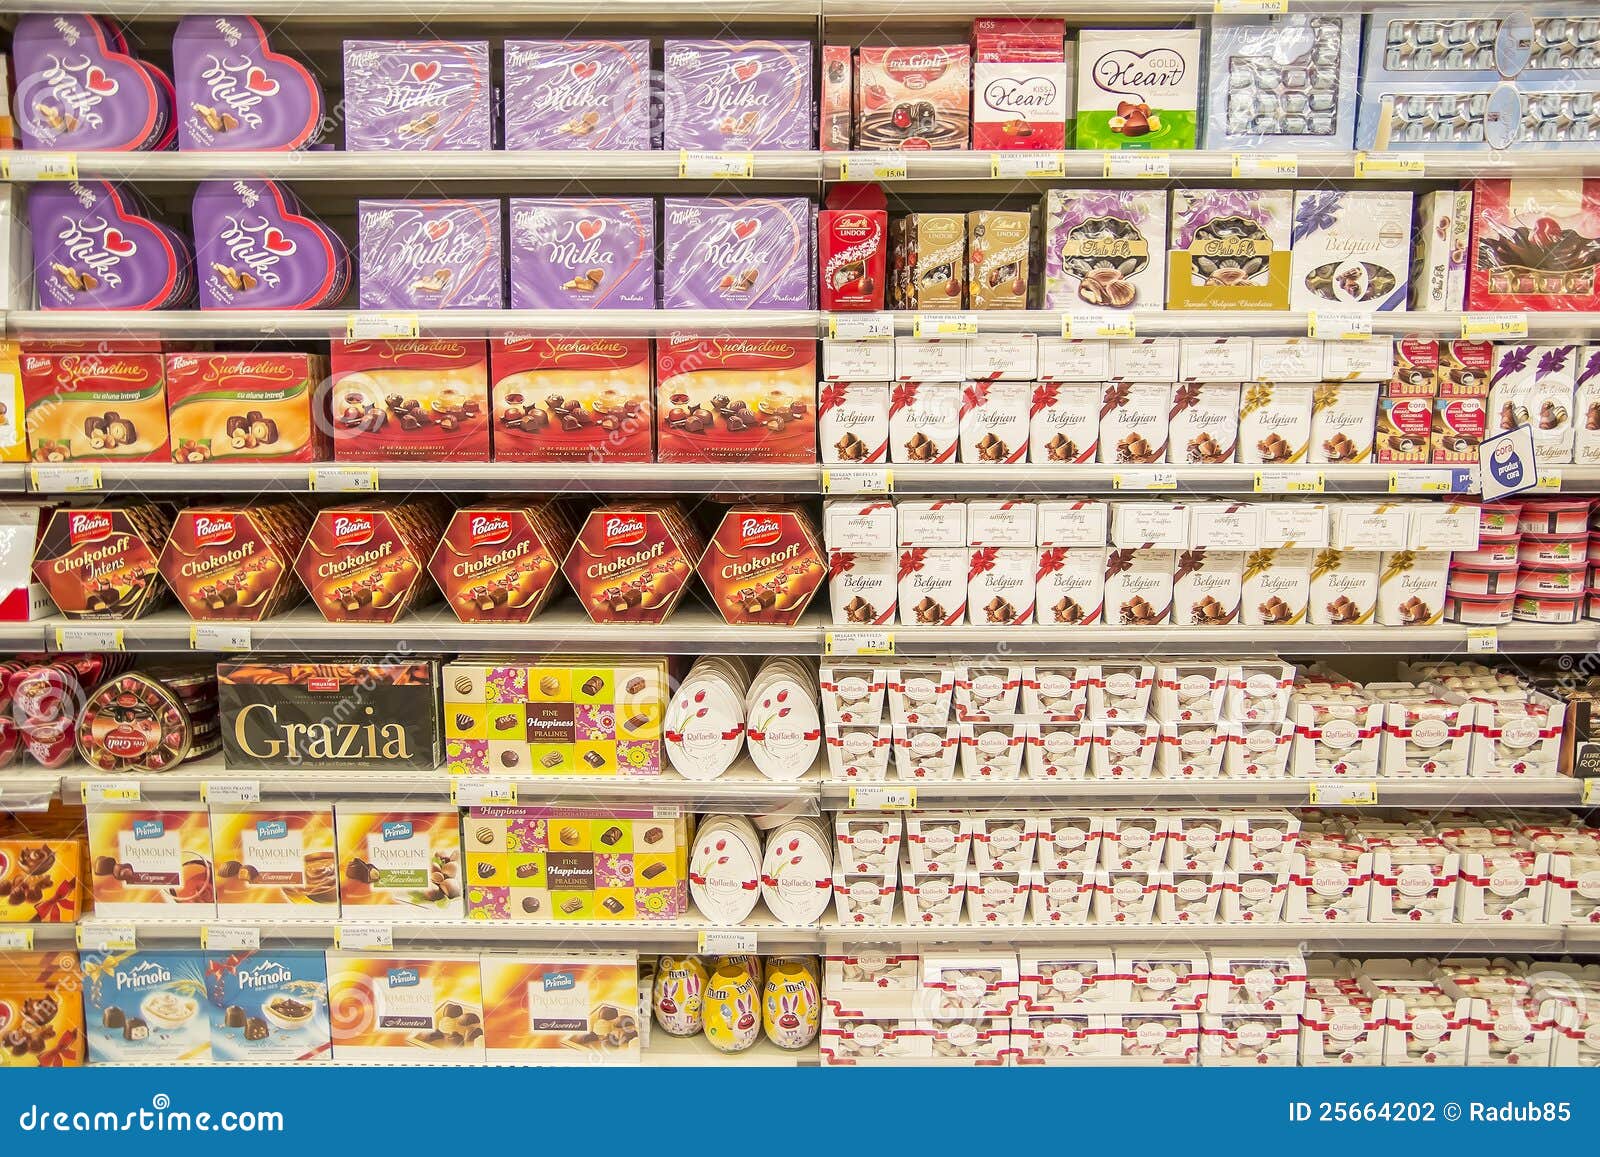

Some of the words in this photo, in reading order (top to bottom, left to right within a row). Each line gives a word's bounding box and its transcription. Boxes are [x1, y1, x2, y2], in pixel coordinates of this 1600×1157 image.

[978, 21, 996, 30] KISS
[909, 53, 944, 69] Gioli
[1148, 59, 1178, 69] GOLD
[1100, 59, 1182, 87] Heart
[42, 54, 103, 130] Milka
[202, 54, 263, 130] Milka
[697, 81, 772, 113] Milka
[990, 86, 1054, 107] Heart
[886, 170, 905, 178] 15.04
[669, 207, 702, 225] Milka
[839, 219, 860, 228] Lindt
[58, 215, 122, 289] Milka
[221, 215, 281, 288] Milka
[547, 240, 614, 269] Milka
[705, 240, 769, 269] Milka
[1325, 236, 1381, 260] Belgian
[868, 325, 879, 333] 21
[957, 322, 967, 330] 22
[1350, 322, 1360, 330] 14
[1500, 322, 1510, 331] 19
[381, 331, 465, 362] Suchardine
[540, 332, 627, 362] Suchardine
[707, 332, 795, 362] Suchardine
[26, 357, 52, 370] Poiana
[57, 357, 147, 382] Suchardine
[173, 358, 199, 370] Poiana
[203, 357, 293, 383] Suchardine
[246, 391, 264, 400] alune
[835, 410, 875, 429] Belgian
[905, 410, 946, 429] Belgian
[976, 410, 1017, 429] Belgian
[1046, 410, 1086, 429] Belgian
[1118, 410, 1157, 429] Belgian
[1188, 410, 1227, 429] Belgian
[1259, 411, 1298, 429] Belgian
[1325, 411, 1364, 429] Belgian
[1494, 442, 1514, 457] cora
[1534, 445, 1569, 459] Belgian
[1498, 461, 1520, 477] produs
[1506, 470, 1520, 481] cora
[862, 479, 872, 488] 12
[1153, 473, 1163, 482] 12
[1297, 483, 1315, 491] 12.21
[72, 516, 110, 535] Poiana
[195, 519, 233, 538] Poiana
[334, 517, 372, 536] Poiana
[472, 517, 510, 536] Poiana
[606, 518, 644, 537] Poiana
[742, 518, 780, 537] Poiana
[54, 536, 131, 575] Chokotoff
[181, 541, 255, 577] Chokotoff
[317, 541, 393, 578] Chokotoff
[453, 540, 531, 578] Chokotoff
[586, 541, 665, 579] Chokotoff
[721, 543, 800, 579] Chokotoff
[85, 557, 125, 581] Intens
[843, 576, 882, 592] Belgian
[913, 576, 952, 592] Belgian
[984, 576, 1024, 592] Belgian
[1053, 576, 1092, 592] Belgian
[1121, 576, 1161, 592] Belgian
[1192, 576, 1231, 592] Belgian
[1260, 576, 1298, 592] Belgian
[1327, 576, 1366, 592] Belgian
[1401, 576, 1438, 592] Belgian
[866, 640, 876, 648] 12
[542, 709, 558, 717] FINE
[235, 702, 415, 761] Grazia
[527, 717, 575, 730] Happiness
[534, 730, 568, 738] PRALINES
[686, 731, 719, 742] Raffaello
[768, 731, 801, 742] Raffaello
[1325, 729, 1356, 739] Raffaello
[1415, 728, 1446, 738] Raffaello
[887, 795, 896, 803] 10
[480, 806, 527, 817] Happiness
[135, 825, 162, 837] Primola
[258, 825, 286, 837] Primola
[384, 826, 412, 838] Primola
[125, 844, 178, 858] PRIMOLINE
[248, 844, 301, 858] PRIMOLINE
[372, 846, 426, 859] PRIMOLINE
[562, 858, 579, 866] FINE
[547, 866, 594, 878] Happiness
[555, 877, 588, 885] PRALINES
[709, 878, 739, 888] Raffaello
[781, 878, 813, 888] Raffaello
[1316, 878, 1348, 888] Raffaello
[1400, 878, 1431, 887] Raffaello
[1492, 878, 1523, 887] Raffaello
[116, 969, 171, 991] Primola
[239, 968, 292, 990] Primola
[389, 974, 417, 986] Primola
[545, 977, 572, 988] Primola
[384, 1017, 427, 1028] Assorted
[539, 1020, 581, 1031] Assorted
[1332, 1023, 1362, 1032] Raffaello
[1415, 1022, 1445, 1032] Raffaello
